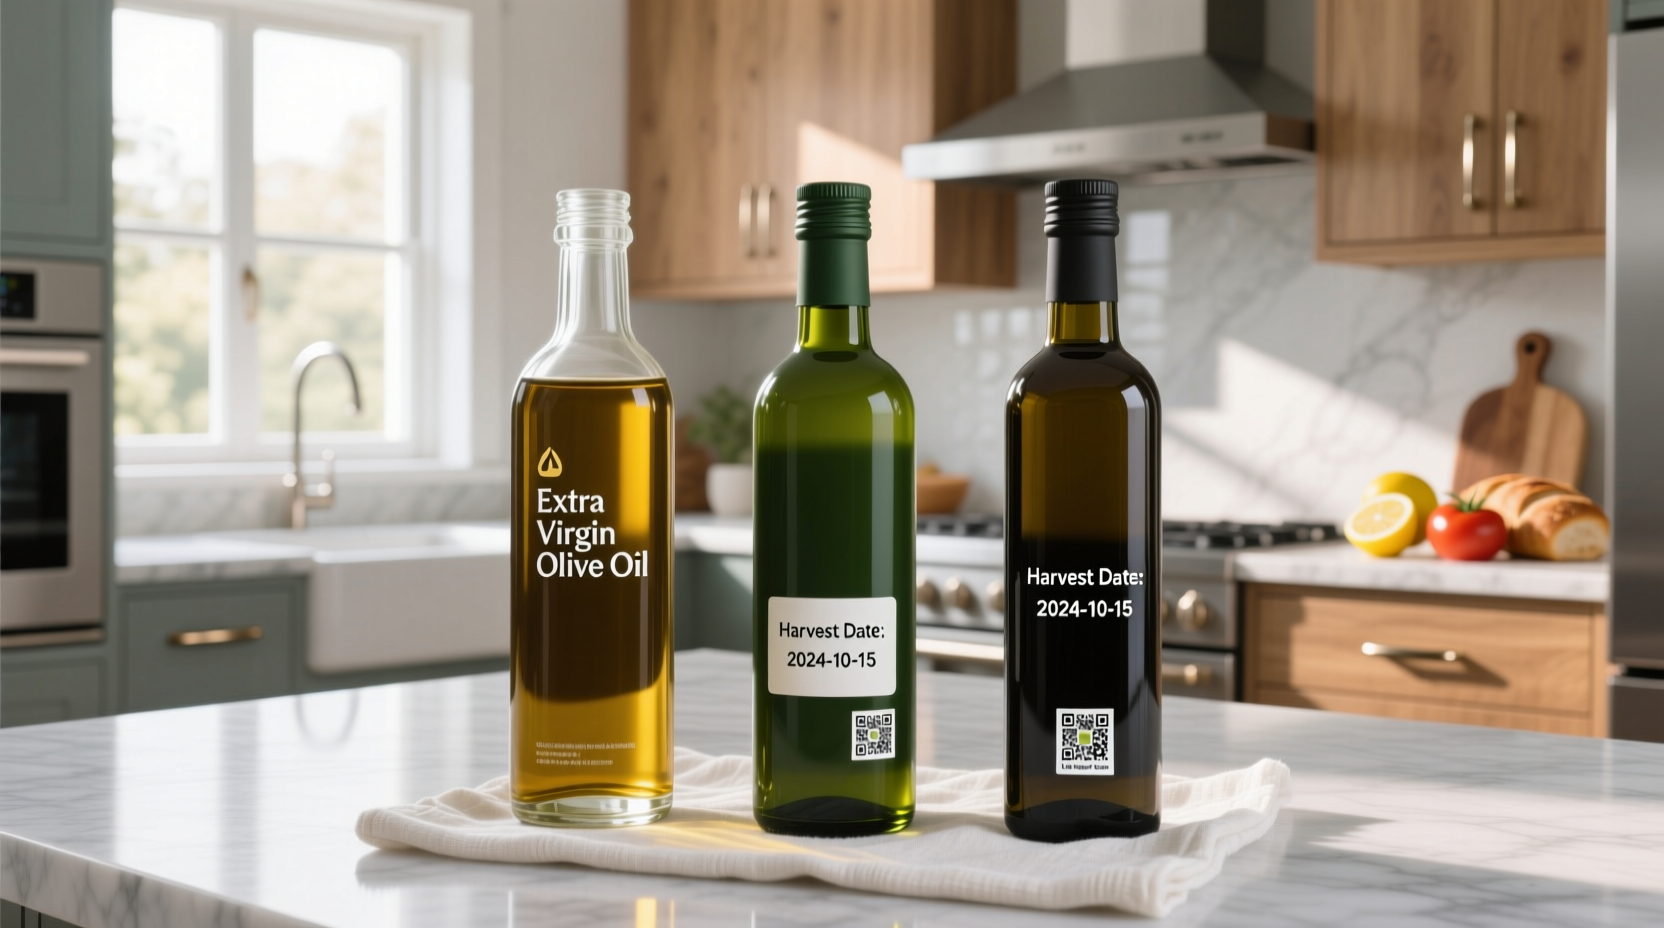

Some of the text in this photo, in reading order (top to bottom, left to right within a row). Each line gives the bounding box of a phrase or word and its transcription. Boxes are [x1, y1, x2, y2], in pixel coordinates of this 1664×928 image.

[537, 488, 605, 513] Extra
[536, 520, 616, 553] Virgin
[536, 550, 648, 578] Olive Oil
[1027, 567, 1144, 586] Harvest Date:
[1036, 600, 1133, 618] 2024-10-15
[779, 622, 885, 639] Harvest Date:
[787, 651, 877, 668] 2024-10-15
